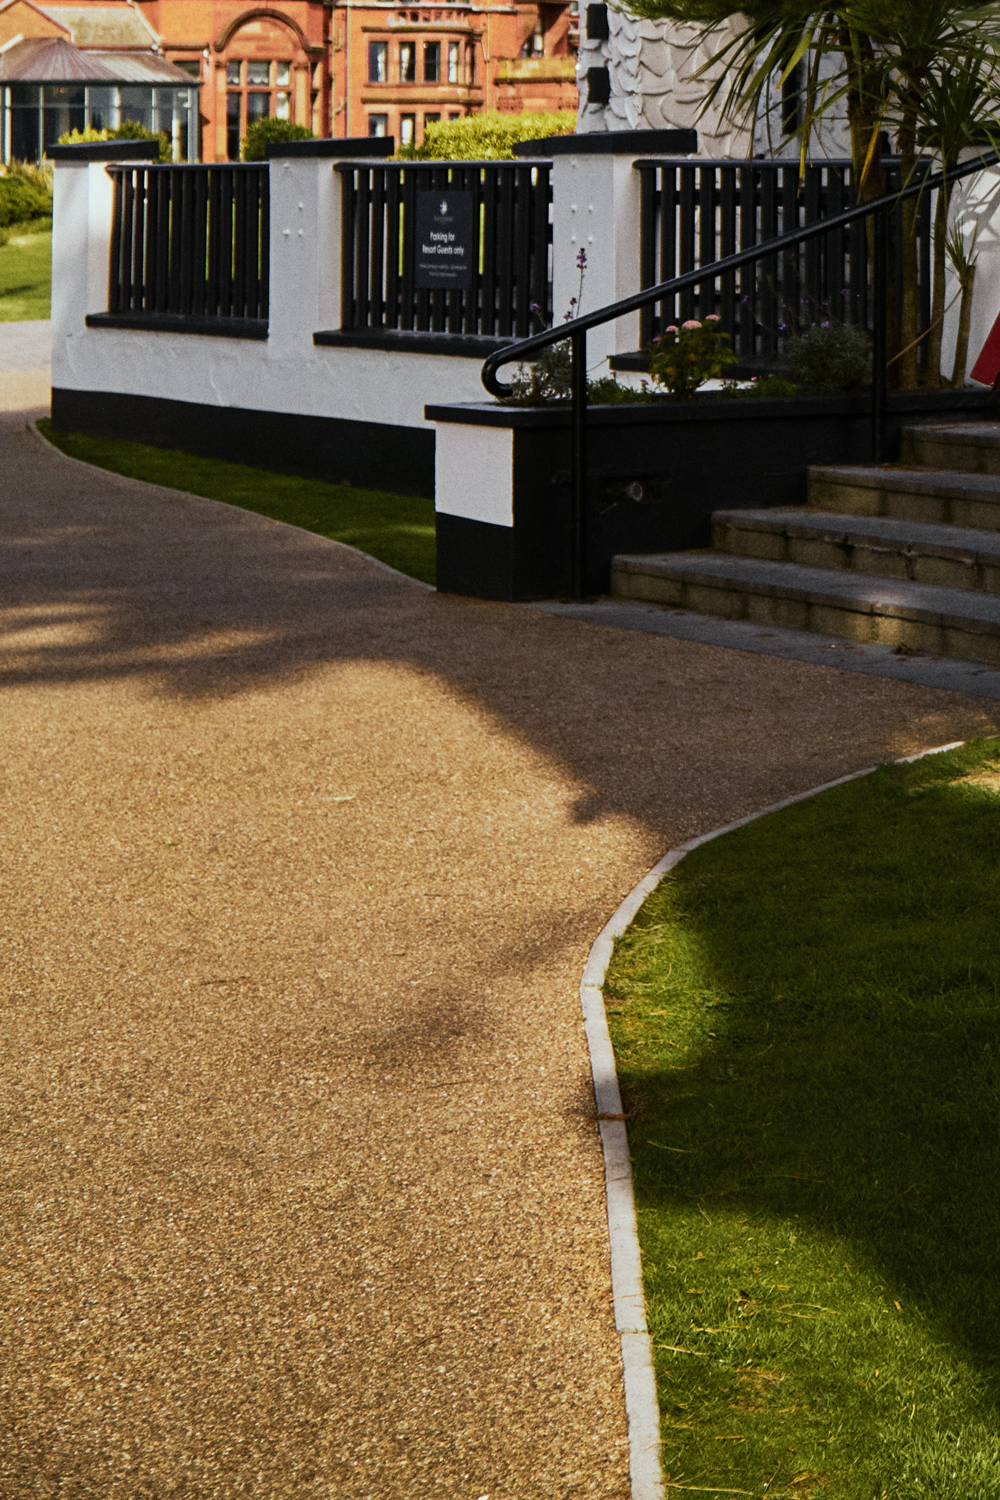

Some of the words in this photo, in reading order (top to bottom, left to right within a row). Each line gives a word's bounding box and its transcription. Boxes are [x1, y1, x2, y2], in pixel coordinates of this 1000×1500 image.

[430, 231, 448, 243] Parking
[437, 244, 453, 255] Guests
[453, 246, 464, 256] only
